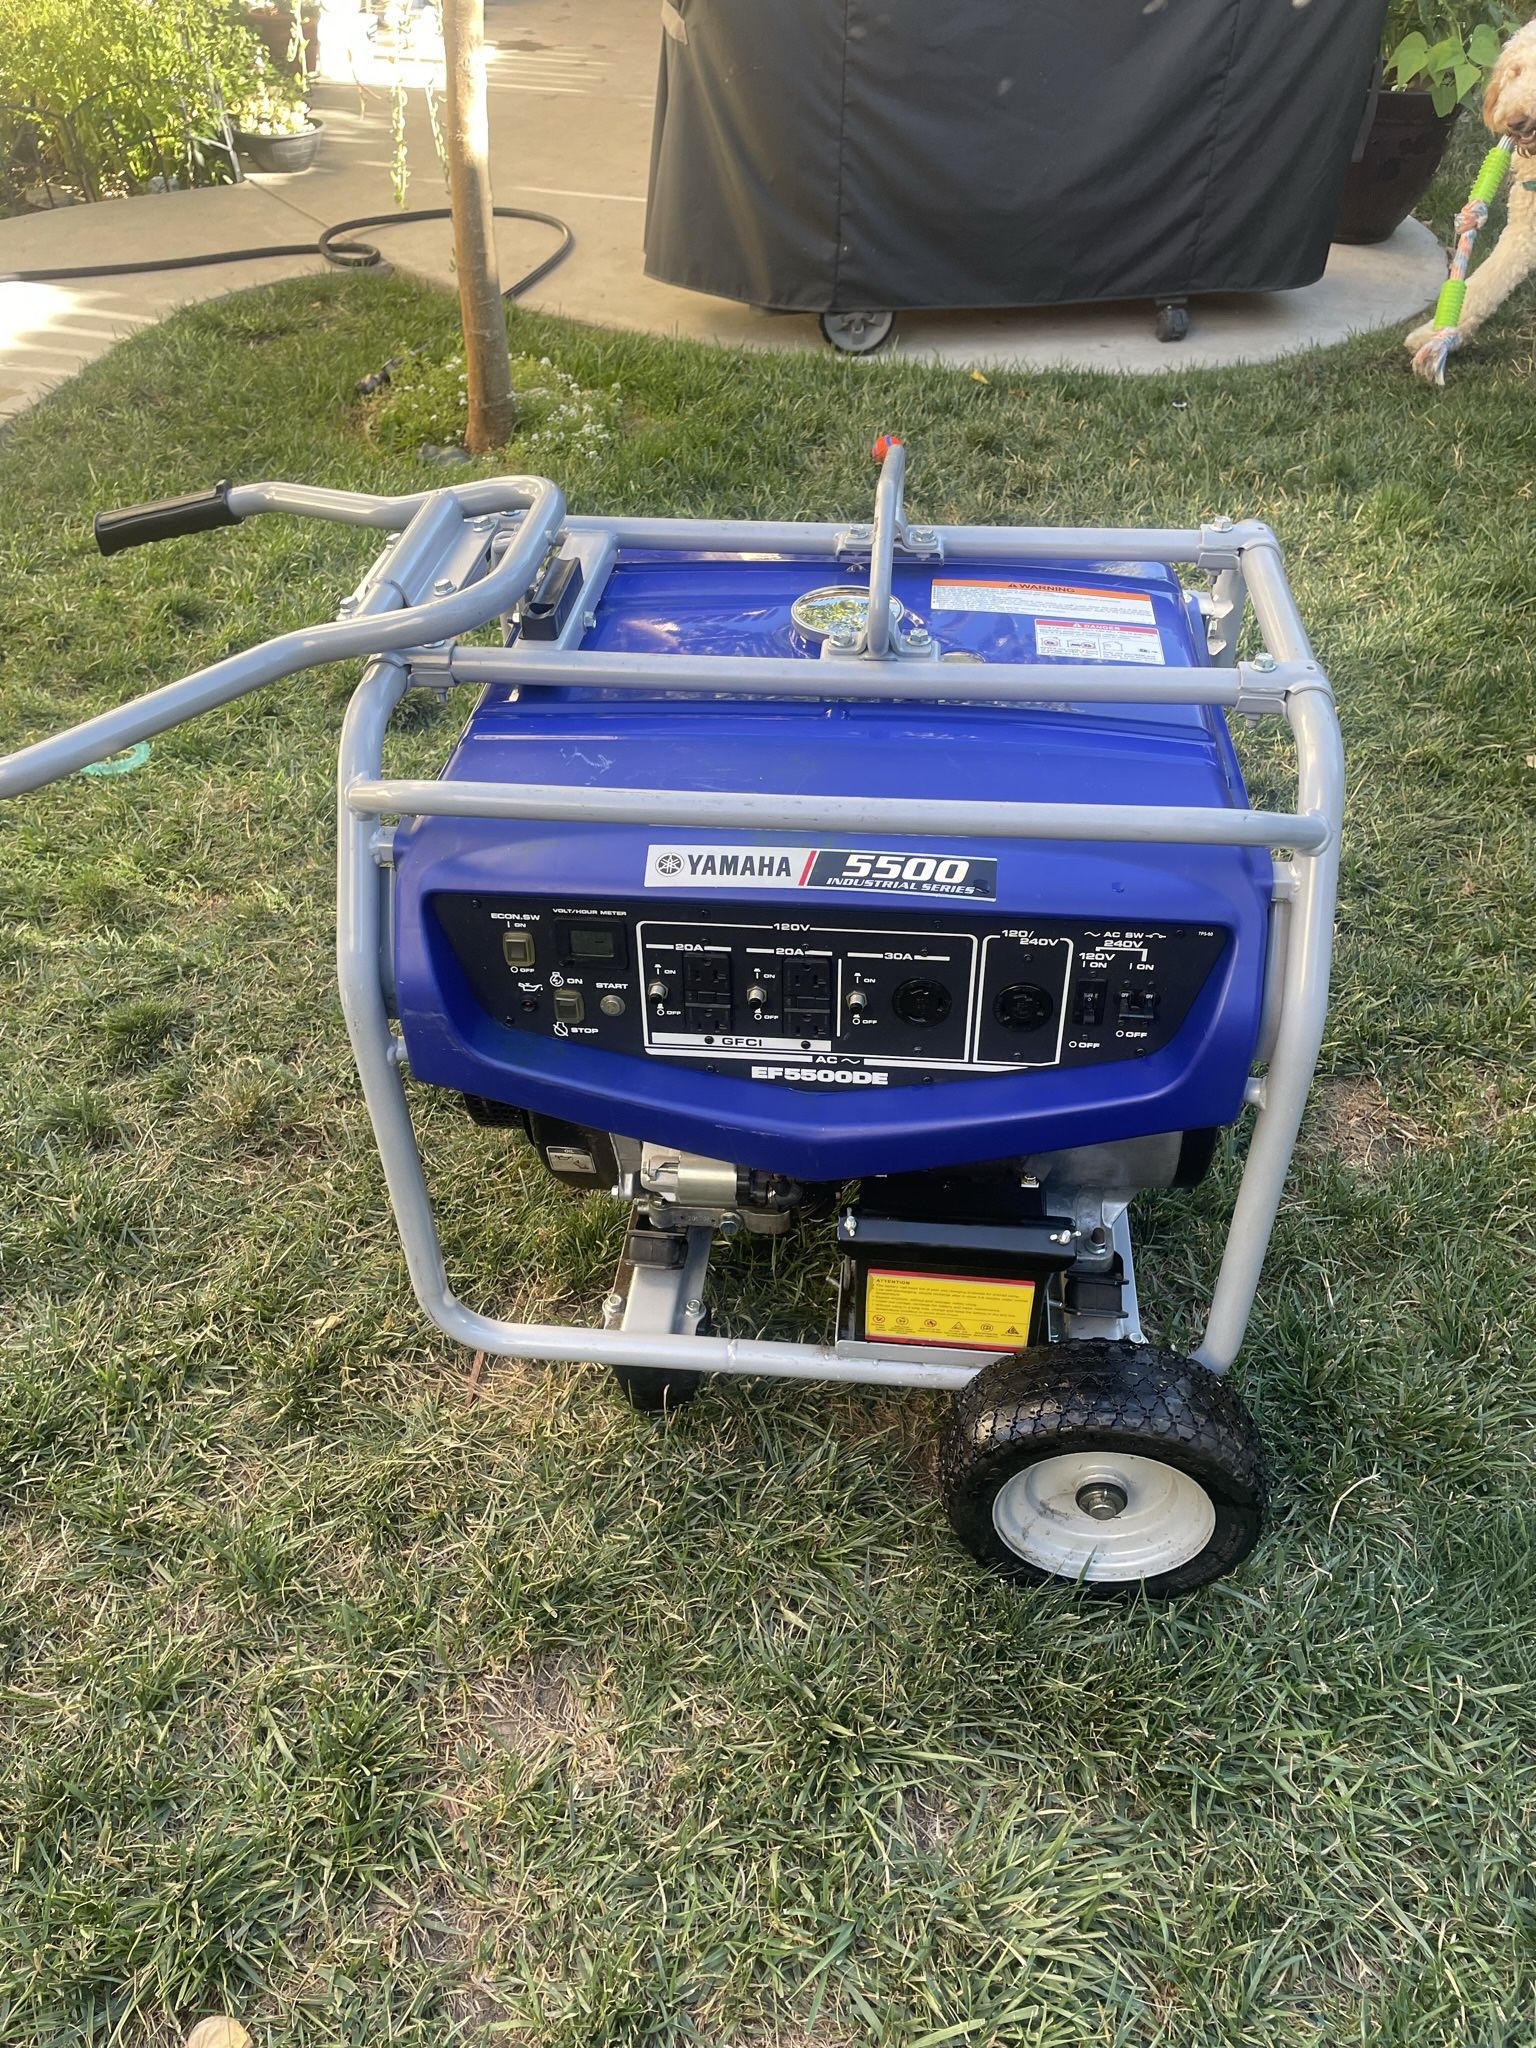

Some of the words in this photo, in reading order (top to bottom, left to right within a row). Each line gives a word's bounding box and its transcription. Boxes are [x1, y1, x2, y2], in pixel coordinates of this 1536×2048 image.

[1019, 584, 1075, 592] WARNING
[688, 854, 792, 877] YAMAHA
[842, 854, 970, 884] 5500
[826, 877, 918, 891] INDUSTRIAL
[921, 884, 976, 895] SERIES
[491, 913, 541, 921] ECON.SW
[773, 923, 810, 931] 120V
[1019, 938, 1059, 946] 240V
[1104, 940, 1143, 948] 240V
[675, 944, 704, 952] 20A
[775, 948, 804, 956] 20A
[884, 952, 914, 960] 30A
[1079, 953, 1115, 961] 120V
[721, 1037, 763, 1047] GFCI
[815, 1056, 837, 1064] AC
[751, 1066, 888, 1085] EF5500DE
